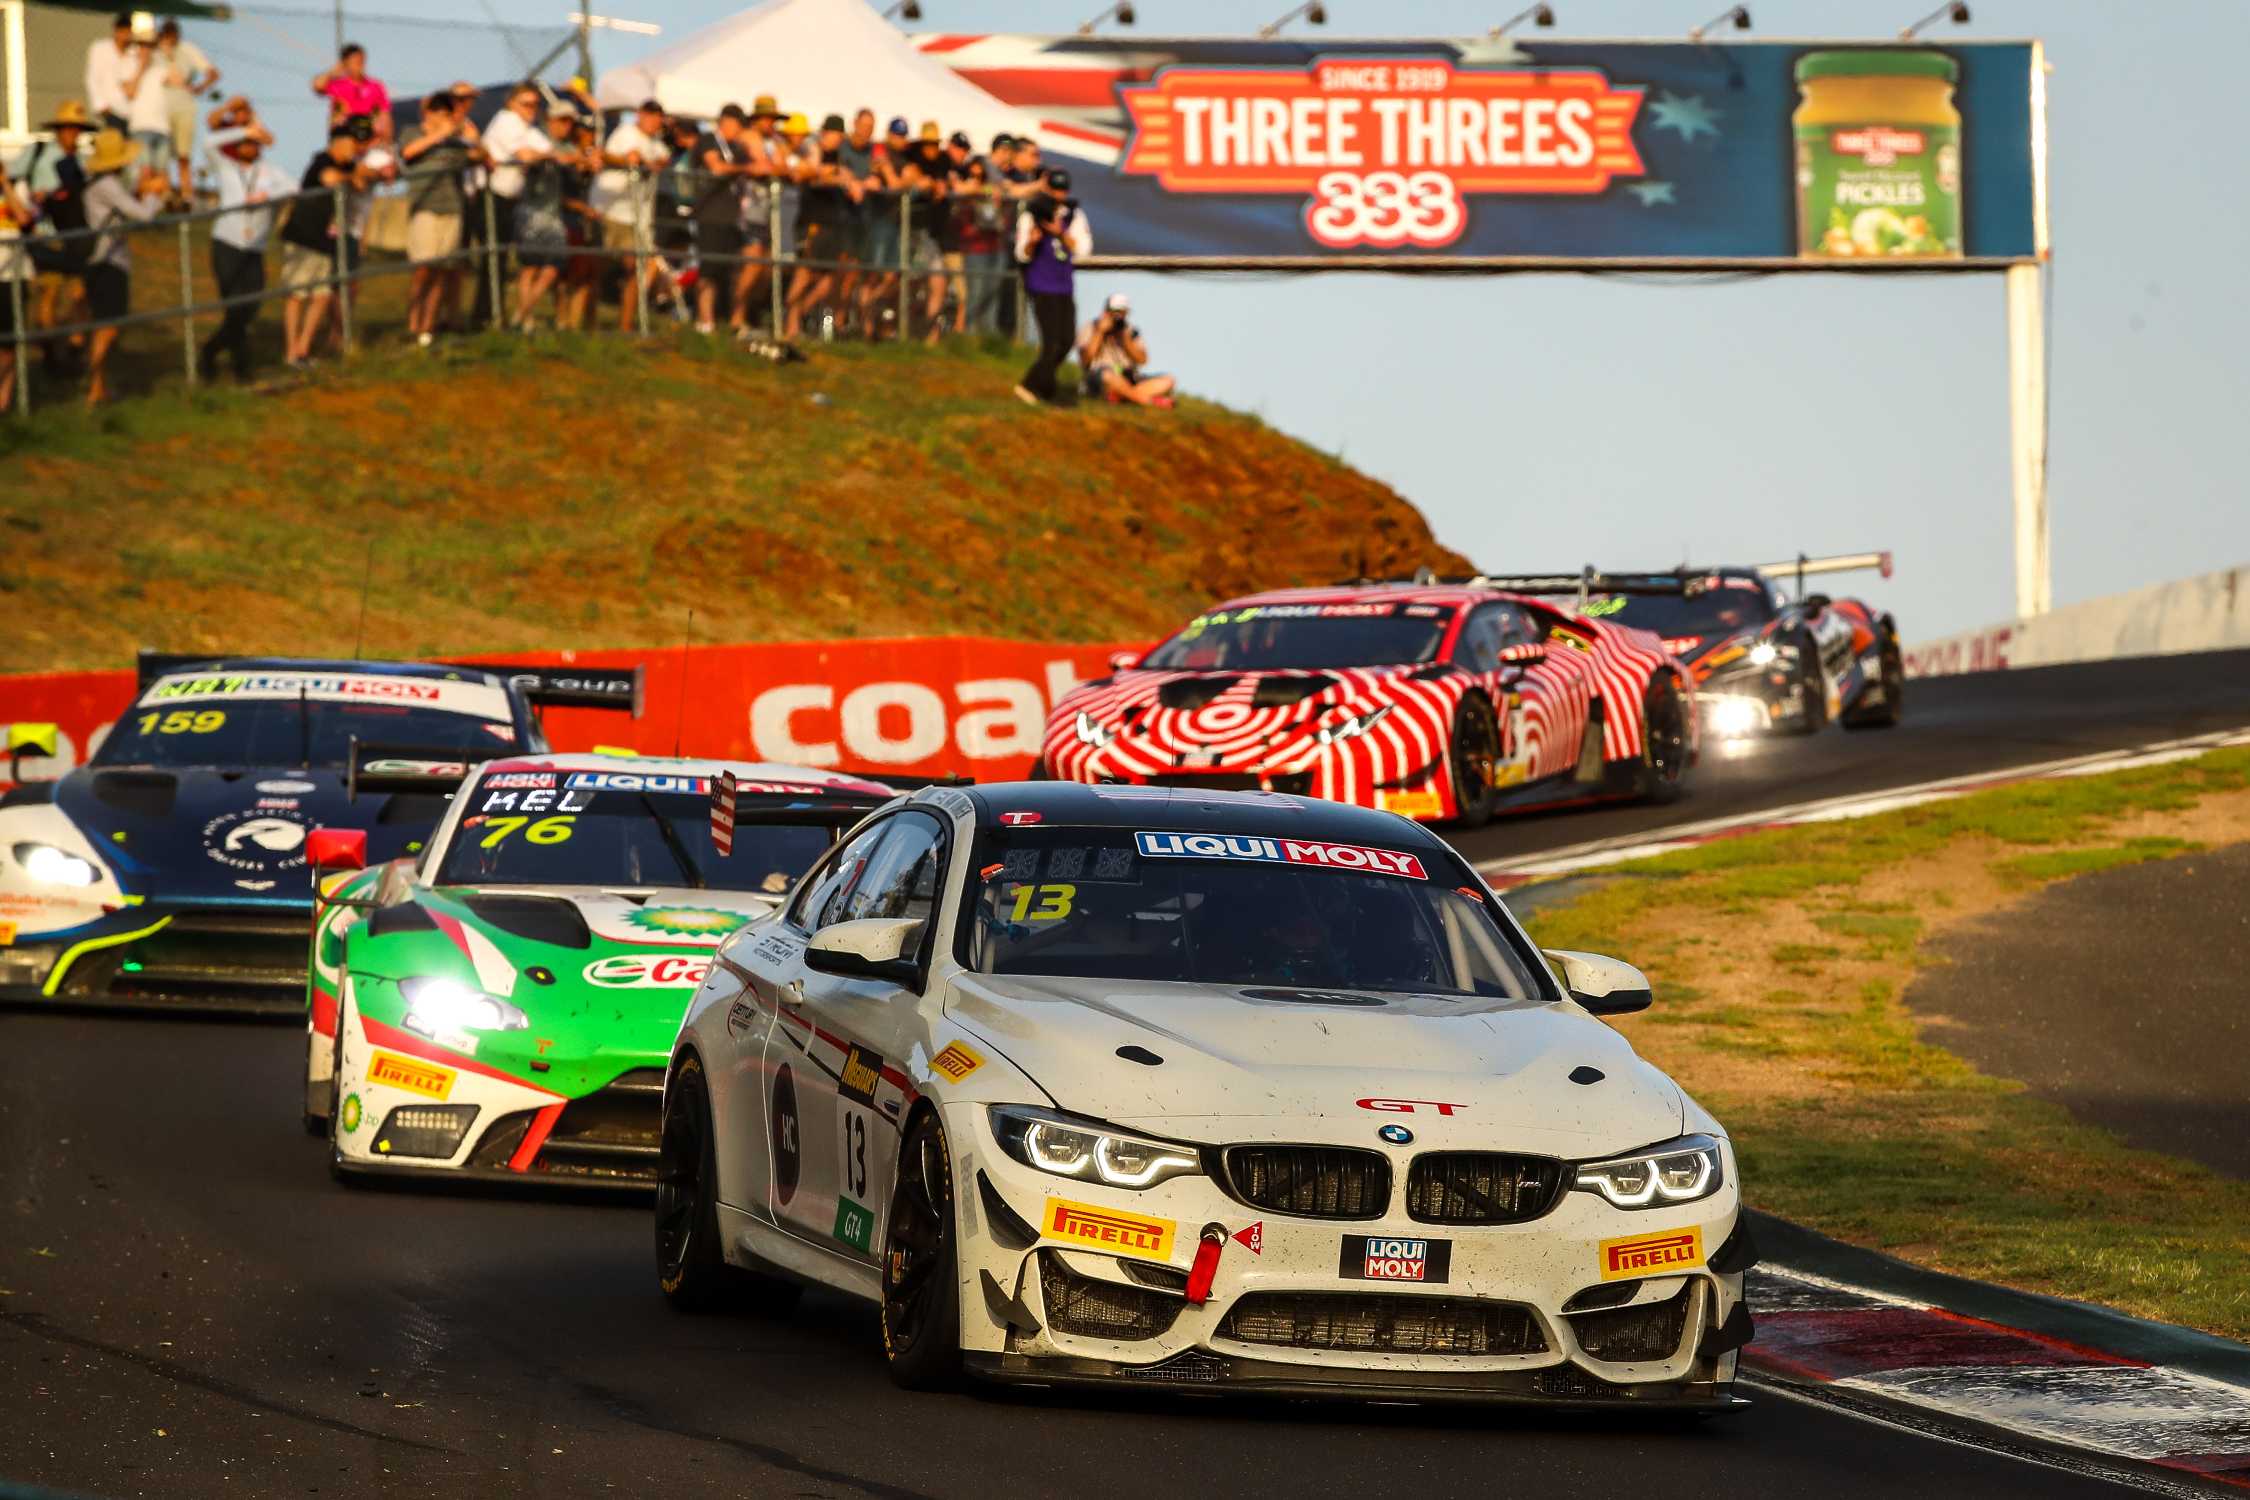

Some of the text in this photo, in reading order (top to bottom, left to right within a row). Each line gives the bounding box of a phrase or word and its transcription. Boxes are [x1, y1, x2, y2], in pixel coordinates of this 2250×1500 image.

[1320, 67, 1448, 90] SINCE 1919
[1174, 98, 1595, 168] THREE THREES
[1312, 170, 1461, 241] 333
[1835, 182, 1926, 206] PICKLES
[245, 676, 341, 692] LIQUI
[345, 680, 439, 698] MOLY
[138, 710, 227, 736] 159
[573, 773, 690, 792] LIQUI
[480, 815, 577, 849] 76
[1145, 834, 1419, 876] LIQUI MOLY
[1010, 884, 1076, 922] 13
[373, 1057, 448, 1093] PIRELLI
[934, 1046, 977, 1078] PIRELLI
[1355, 1097, 1470, 1117] GT
[845, 1110, 866, 1199] 13
[843, 1211, 862, 1242] GT4
[1052, 1206, 1164, 1251] PIRELLI
[1249, 1225, 1261, 1250] TOW
[1368, 1240, 1424, 1260] LIQUI
[1607, 1234, 1695, 1272] PIRELLI
[1367, 1259, 1424, 1278] MOLY
